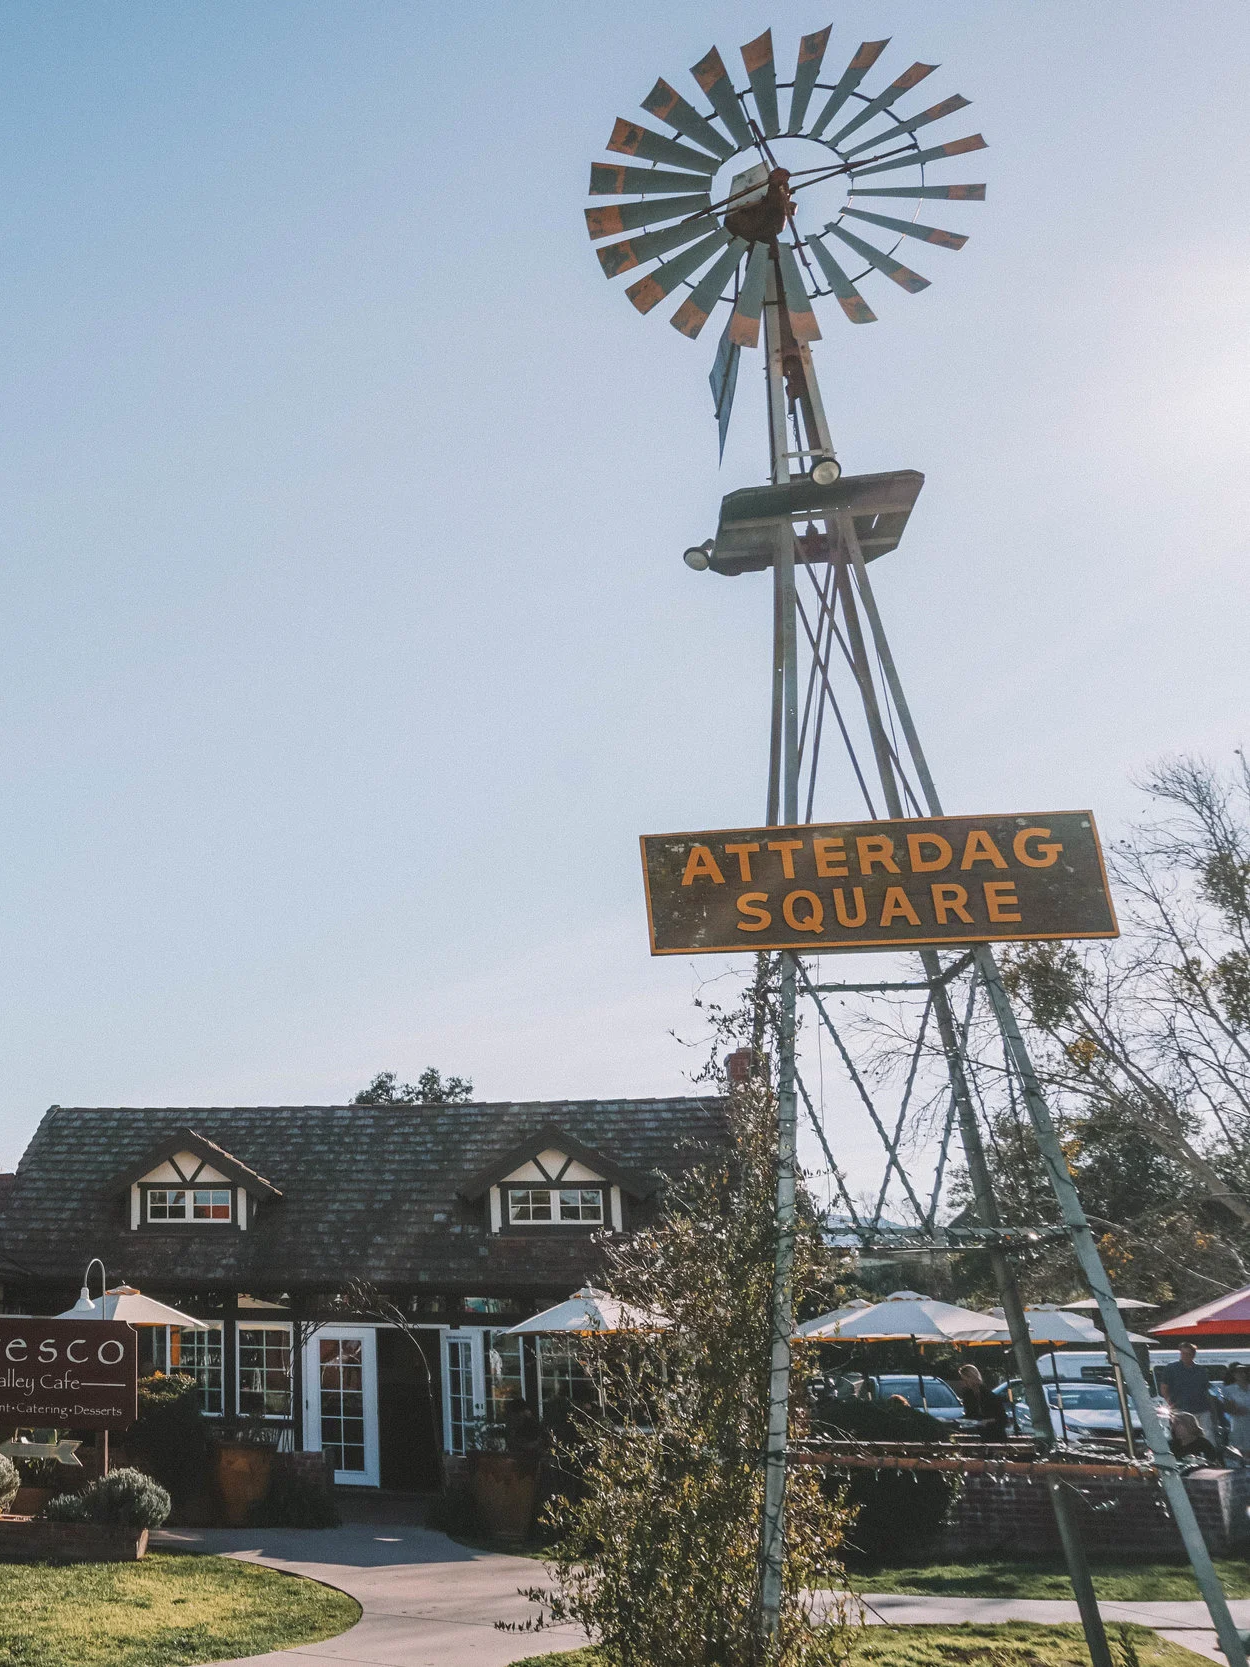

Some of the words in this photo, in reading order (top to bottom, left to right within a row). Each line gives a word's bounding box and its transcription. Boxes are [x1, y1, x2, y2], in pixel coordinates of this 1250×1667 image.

[681, 827, 1063, 886] ATTERDAG
[736, 881, 1022, 934] SQUARE
[40, 1370, 80, 1390] Cafe
